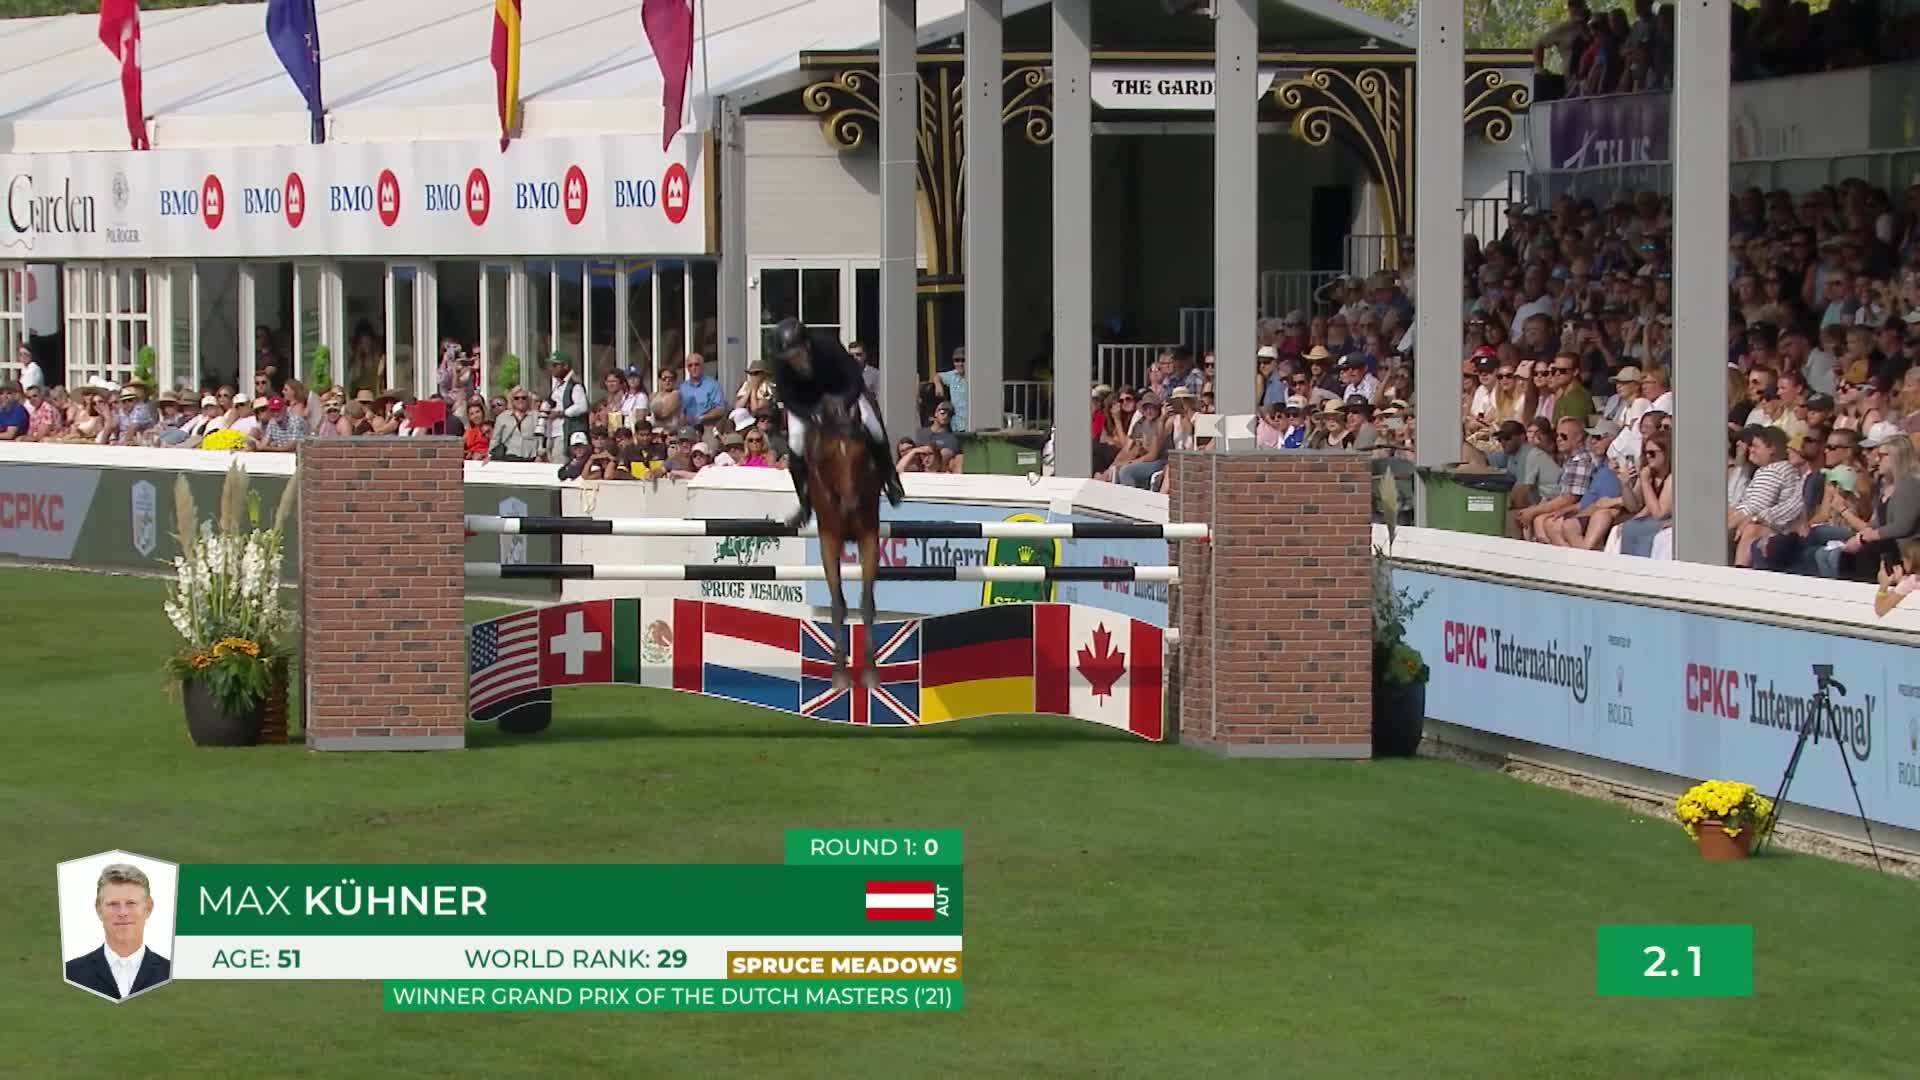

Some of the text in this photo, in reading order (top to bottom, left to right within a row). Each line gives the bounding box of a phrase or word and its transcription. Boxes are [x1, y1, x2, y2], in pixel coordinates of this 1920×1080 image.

[1112, 79, 1217, 95] THE GARD
[8, 173, 96, 233] Garden
[160, 190, 198, 215] BMO
[244, 188, 281, 214] BMO
[330, 185, 373, 211] BMO
[425, 184, 461, 211] BMO
[516, 182, 559, 210] BMO
[615, 179, 656, 208] BMO
[0, 492, 65, 531] CPKC
[840, 537, 908, 567] CKC
[701, 581, 803, 602] SPRUCE MEADOWS
[1444, 620, 1488, 669] CPKC
[1686, 663, 1740, 720] CPKC
